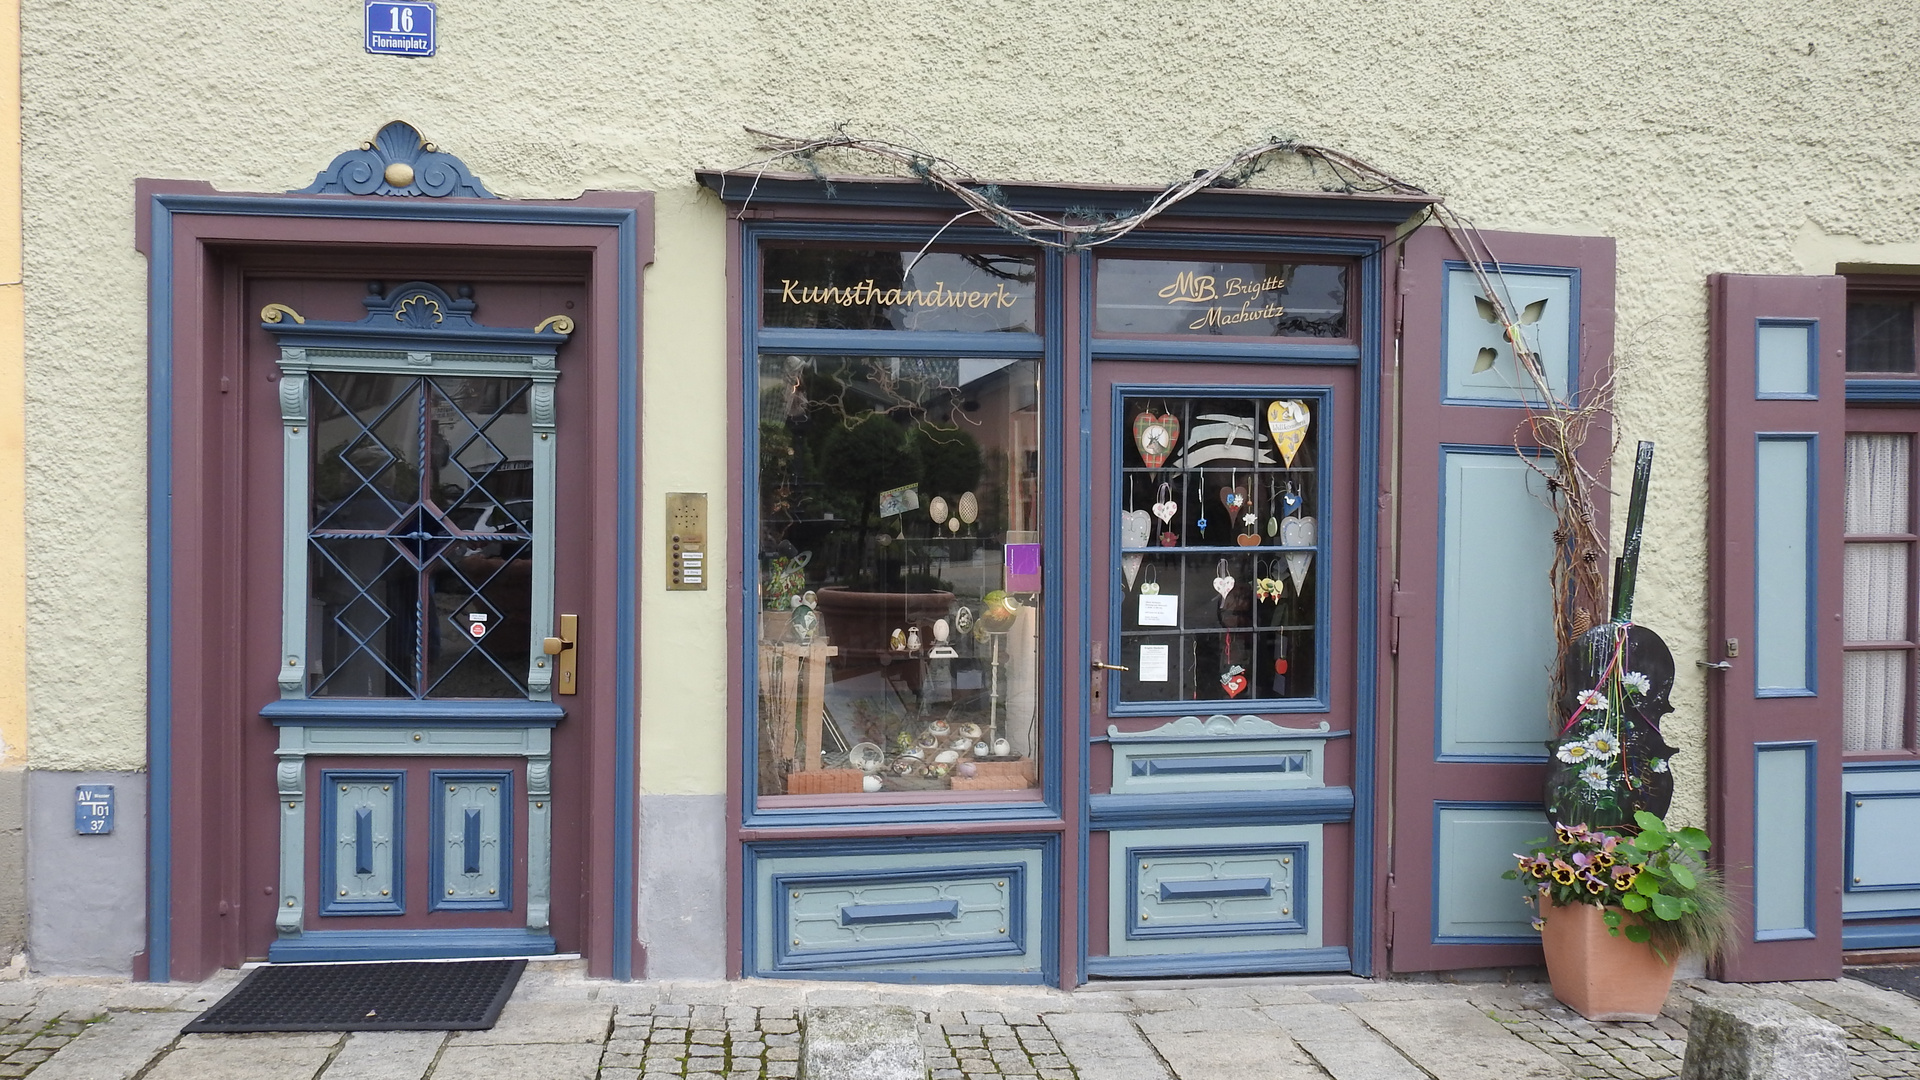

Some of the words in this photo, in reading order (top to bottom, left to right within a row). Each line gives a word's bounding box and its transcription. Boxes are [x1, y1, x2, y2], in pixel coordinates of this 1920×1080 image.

[390, 7, 414, 33] 16
[372, 35, 428, 51] Florianiplatz
[781, 279, 1018, 309] Kunsthandwerk
[1223, 276, 1285, 300] Brigitte
[1188, 301, 1284, 330] Machwitz
[1272, 420, 1306, 431] Willkomn
[78, 791, 92, 801] AV
